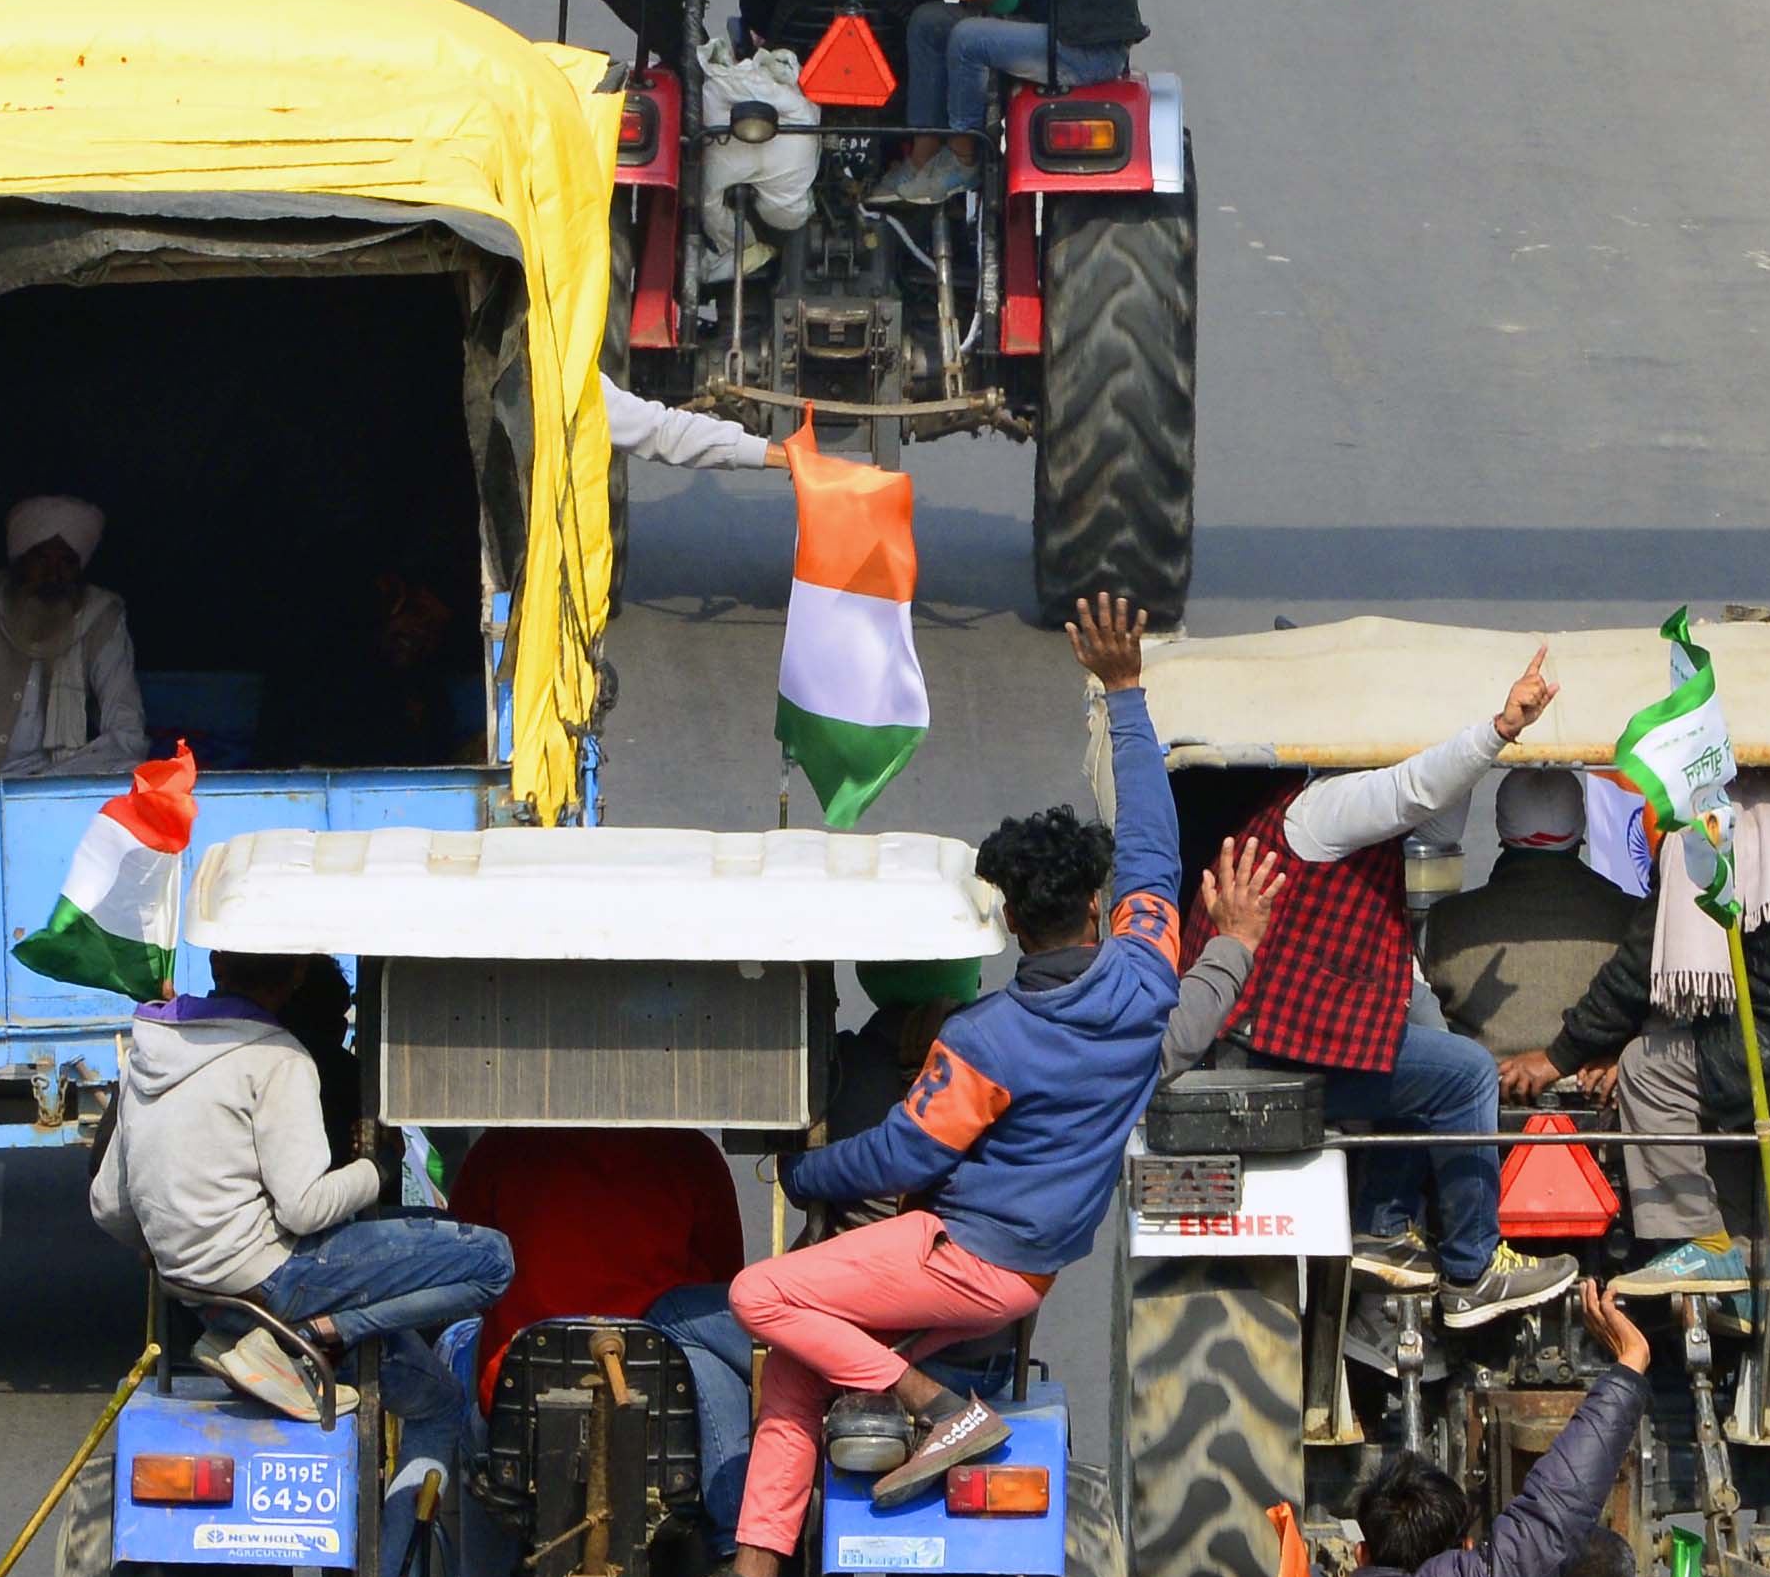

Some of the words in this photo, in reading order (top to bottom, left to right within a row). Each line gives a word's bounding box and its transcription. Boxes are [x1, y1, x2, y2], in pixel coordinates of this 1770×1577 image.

[1180, 1214, 1295, 1236] EICHER
[262, 1462, 328, 1483] PB19E
[252, 1486, 336, 1513] 6450
[228, 1533, 260, 1543] NEW
[229, 1549, 305, 1559] AGRICULTURE
